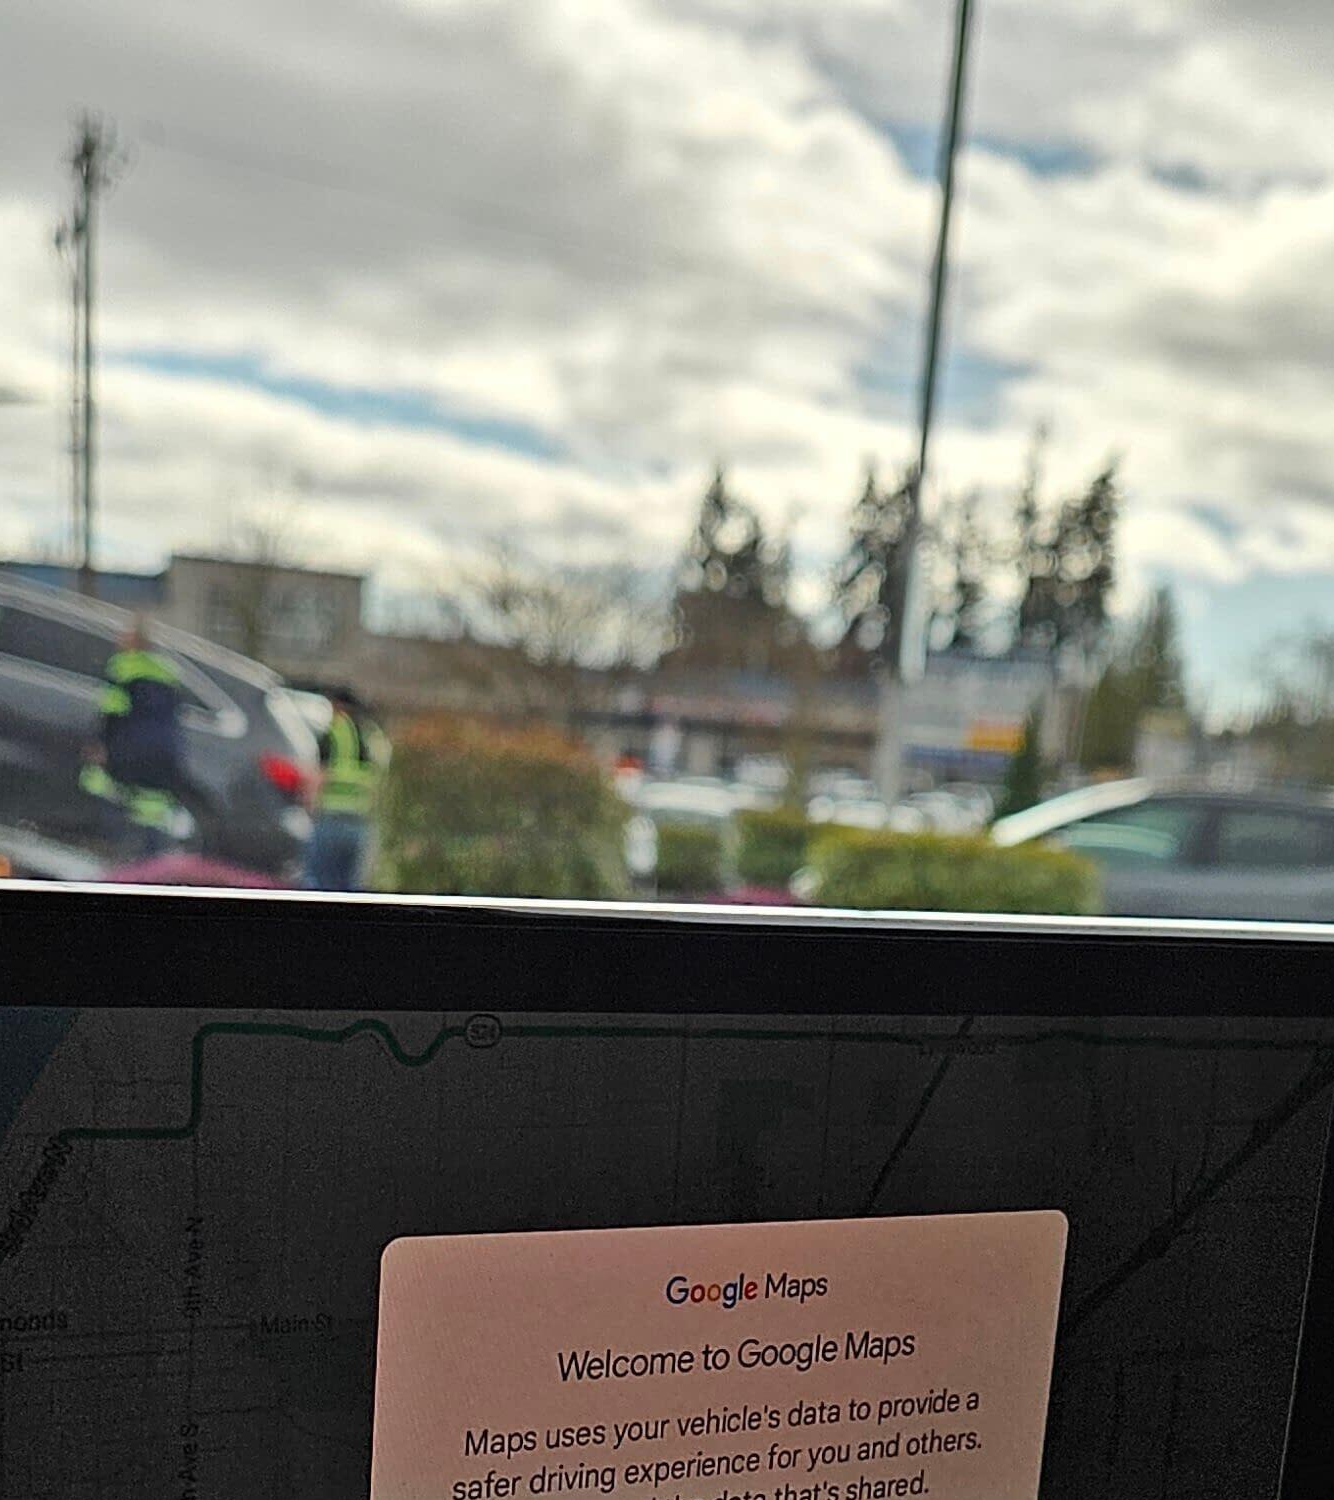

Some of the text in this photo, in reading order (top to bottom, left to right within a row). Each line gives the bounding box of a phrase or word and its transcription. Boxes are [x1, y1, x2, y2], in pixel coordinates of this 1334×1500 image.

[665, 1271, 828, 1309] Google Maps
[557, 1331, 916, 1383] Welcome to Google Maps
[464, 1388, 979, 1460] Maps uses your vehicle's data to provide a
[177, 1442, 199, 1483] Ave
[528, 1461, 616, 1500] driving
[623, 1447, 761, 1489] experience
[767, 1444, 801, 1475] for
[806, 1441, 851, 1475] you
[857, 1433, 899, 1464] and
[906, 1424, 983, 1456] others.
